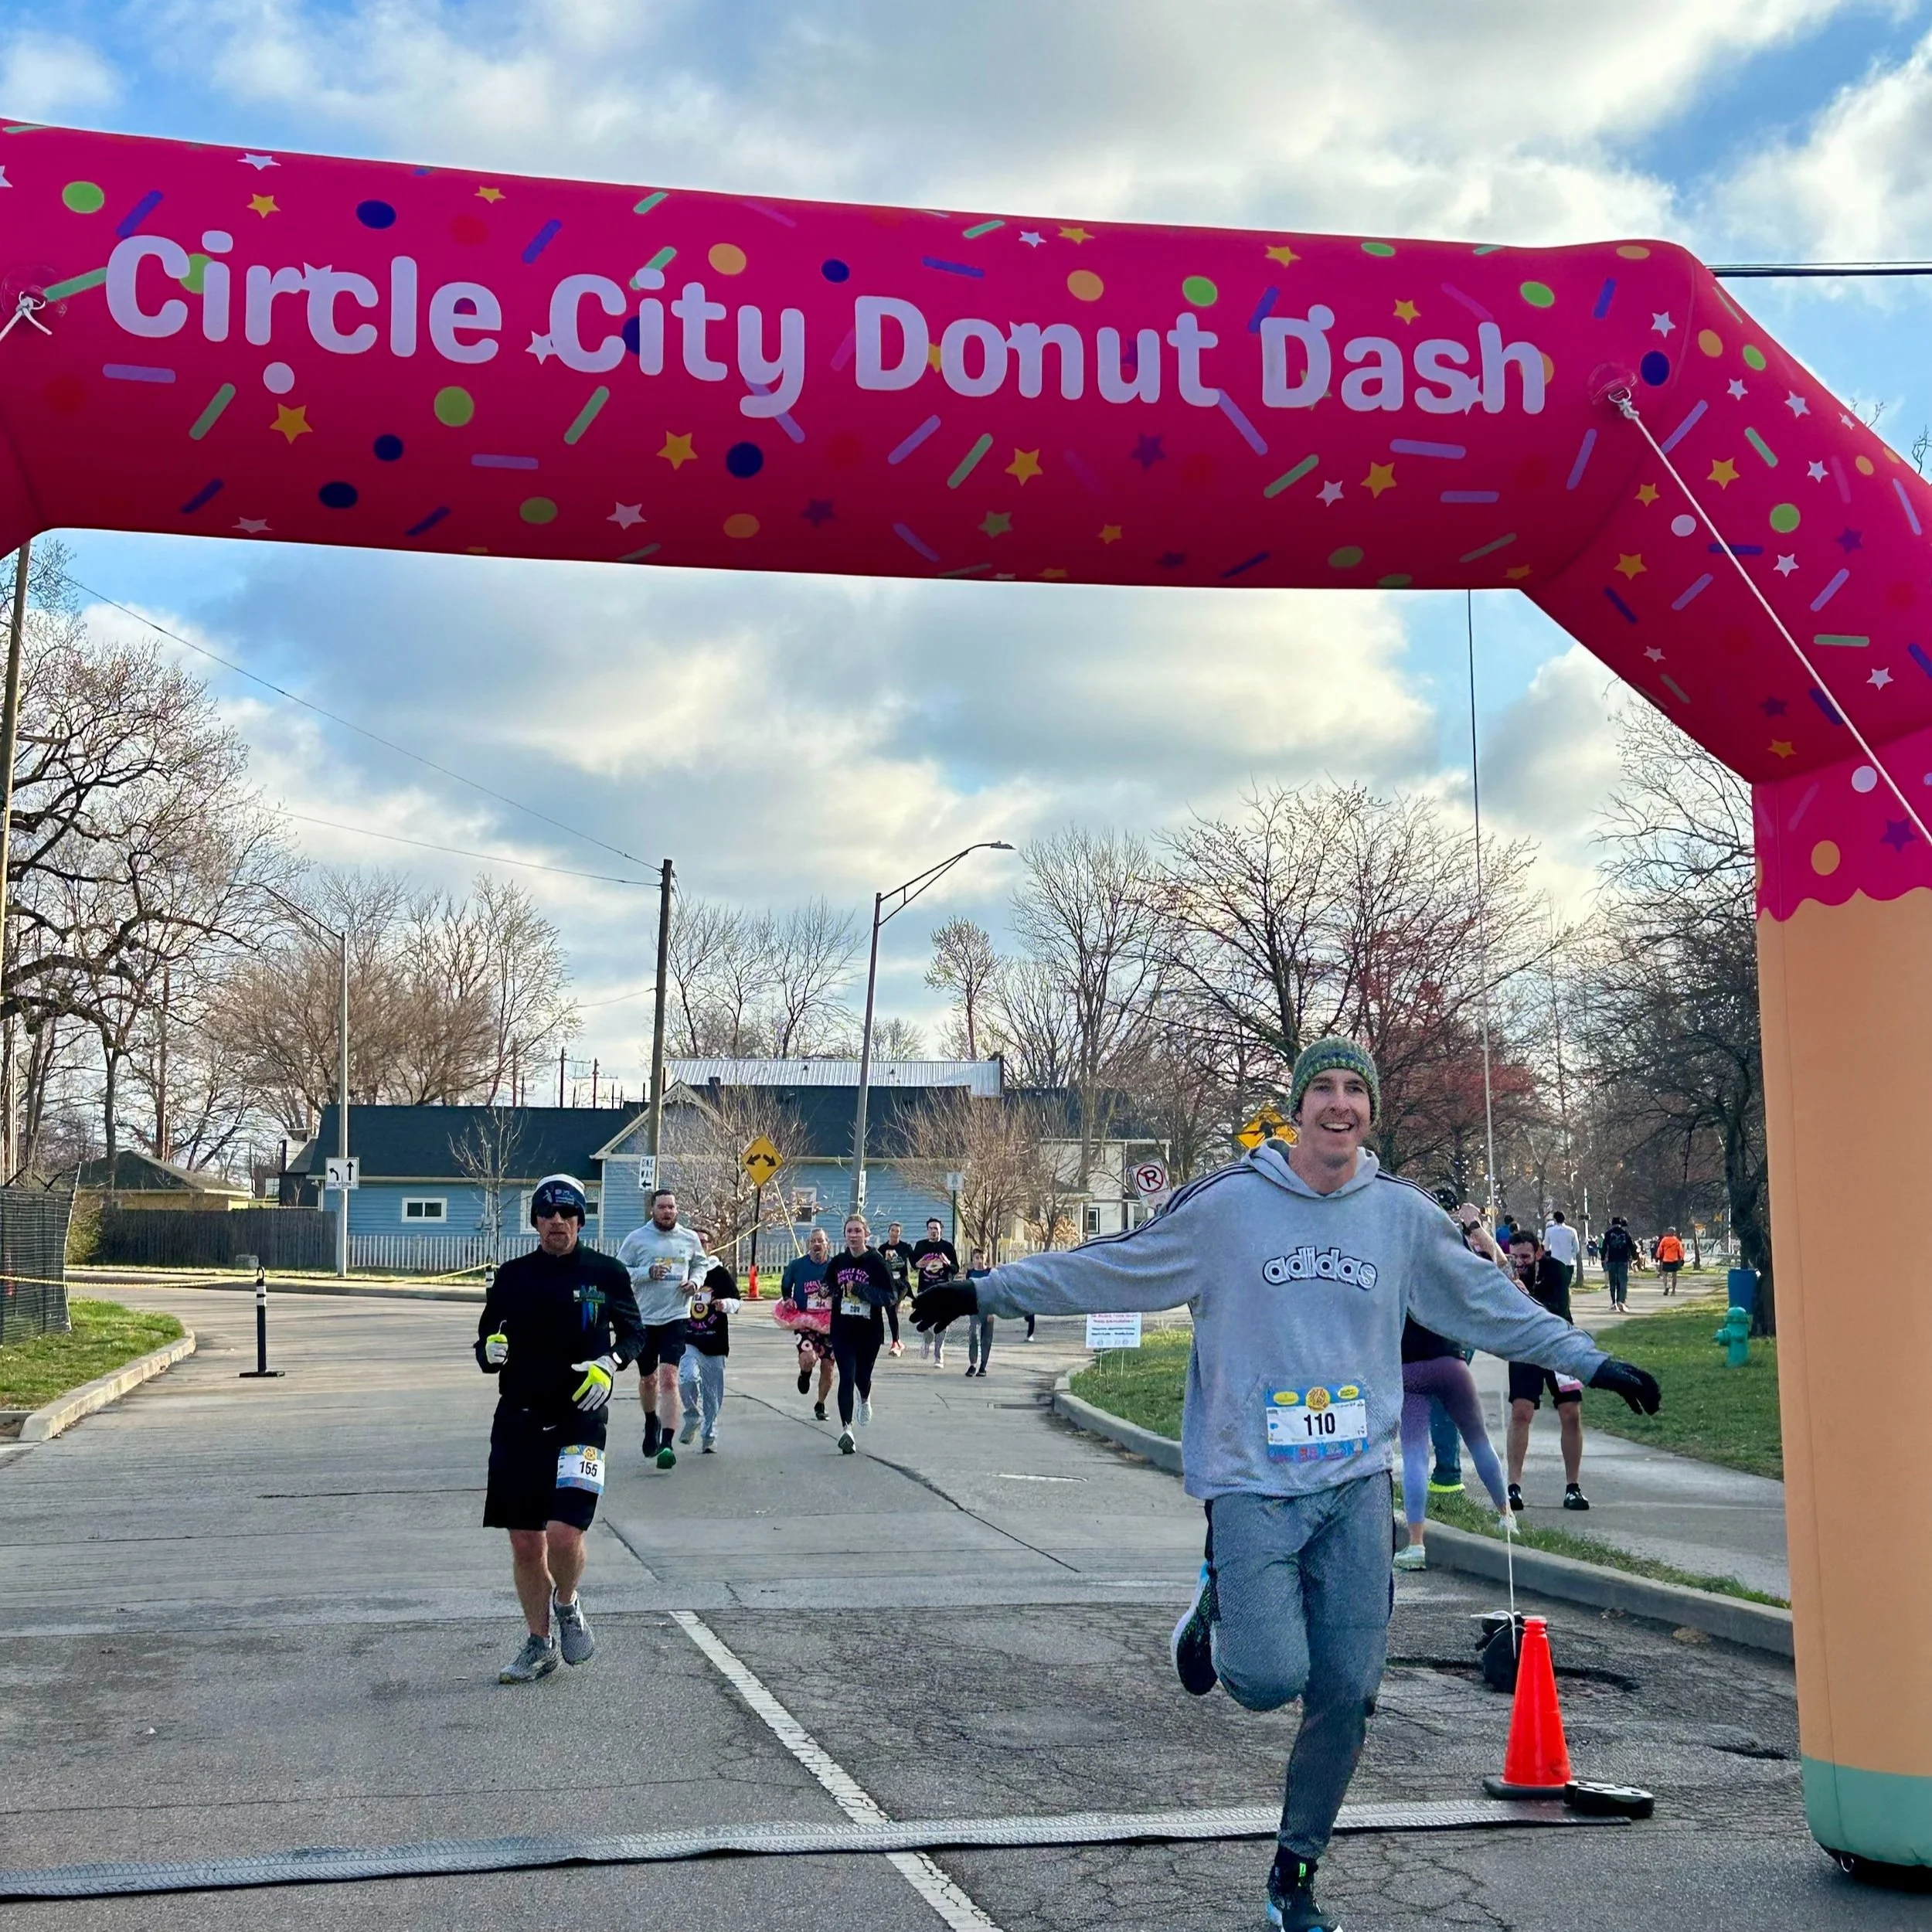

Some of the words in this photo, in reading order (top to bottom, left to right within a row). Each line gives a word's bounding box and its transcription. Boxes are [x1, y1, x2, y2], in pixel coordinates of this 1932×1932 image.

[106, 231, 501, 364] Circle
[548, 267, 804, 418] City
[855, 296, 1219, 406] Donut
[1261, 317, 1546, 413] Dash
[1143, 1169, 1158, 1188] P
[1263, 1246, 1378, 1291] adidas
[1303, 1412, 1336, 1436] 110
